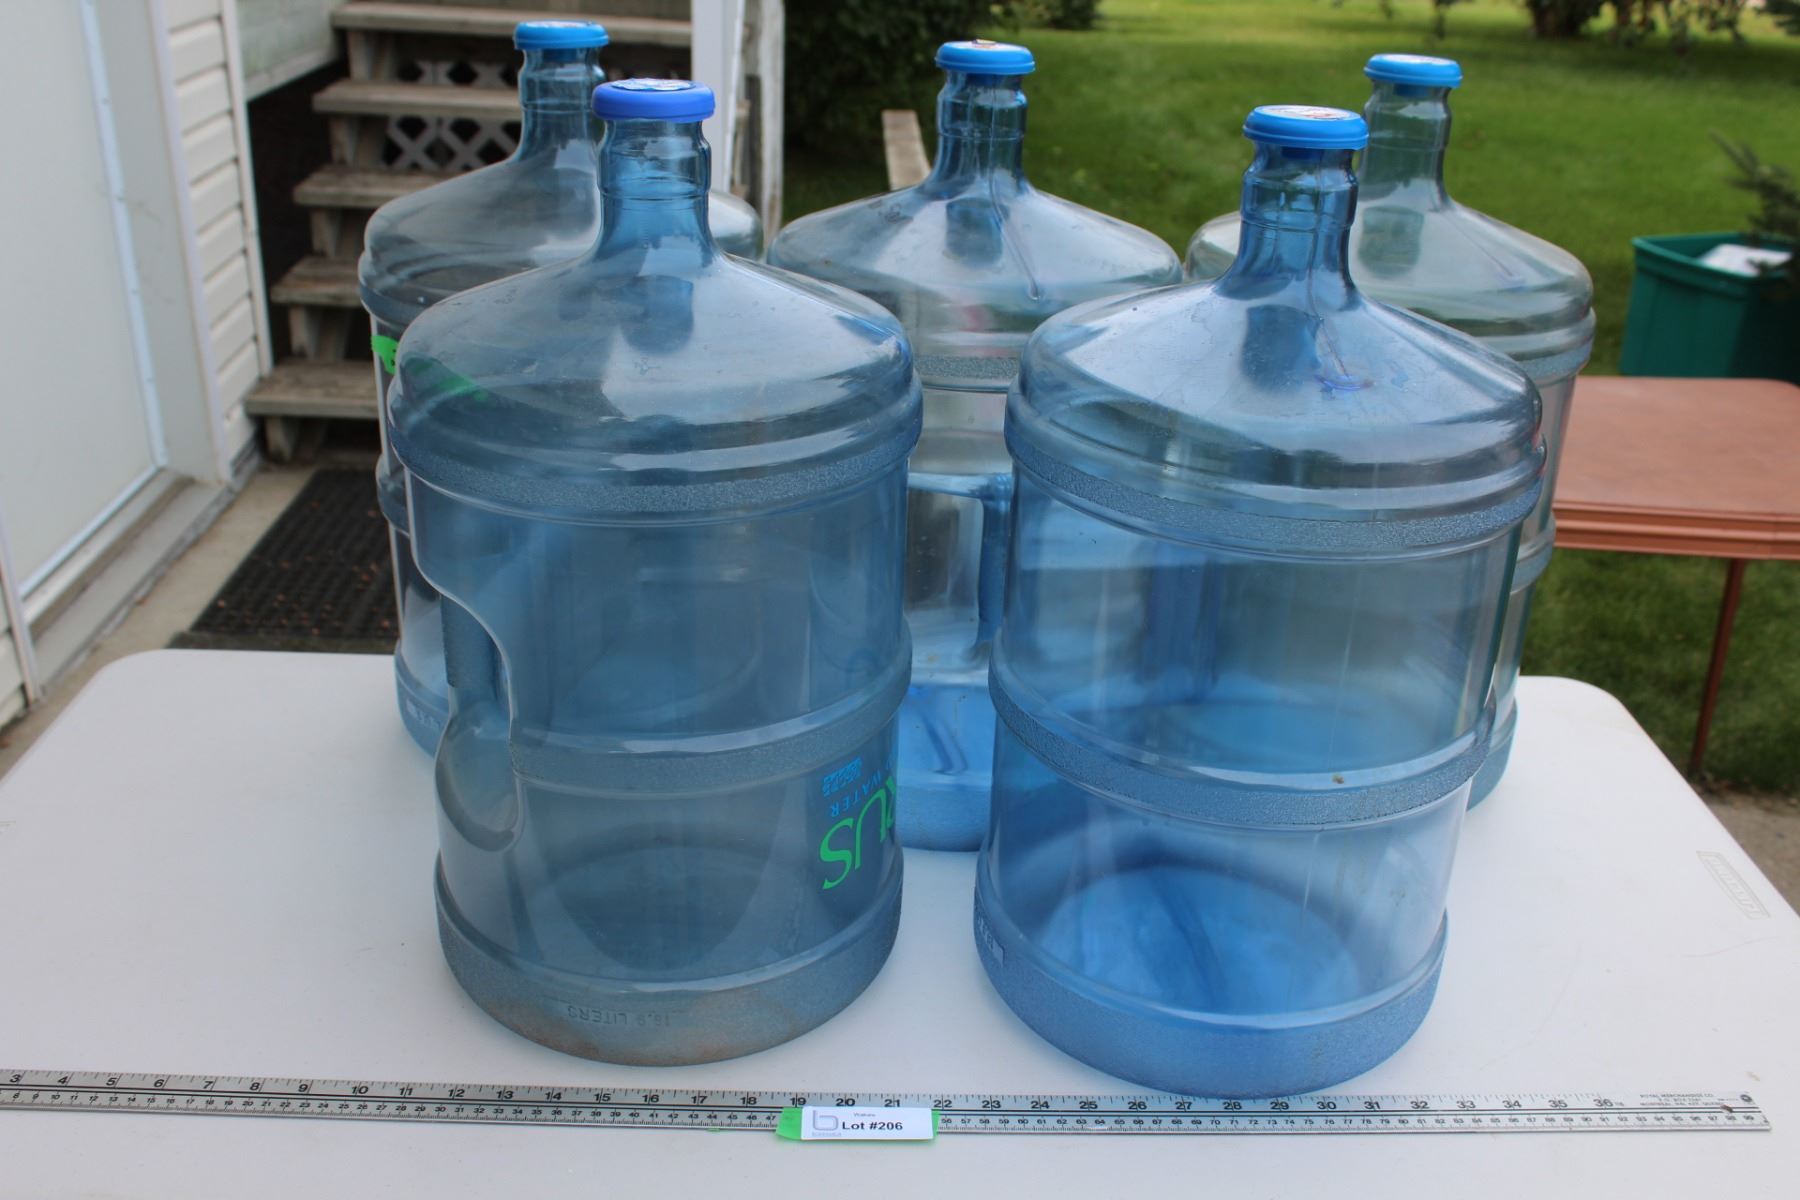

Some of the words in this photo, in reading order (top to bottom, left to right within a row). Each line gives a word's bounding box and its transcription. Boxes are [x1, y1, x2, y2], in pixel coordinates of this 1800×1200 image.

[567, 1004, 628, 1025] LITERS
[10, 1074, 20, 1084] 3
[58, 1076, 68, 1084] 4
[106, 1078, 117, 1086] 5
[154, 1079, 164, 1087] 6
[250, 1082, 260, 1090] 8
[299, 1083, 309, 1092] 9
[352, 1086, 368, 1094] 10
[399, 1087, 413, 1095] 11
[448, 1088, 464, 1097] 12
[497, 1090, 513, 1099] 13
[546, 1091, 562, 1100] 14
[594, 1092, 610, 1101] 15
[643, 1094, 660, 1103] 16
[692, 1095, 708, 1104] 17
[741, 1097, 757, 1105] 18
[790, 1097, 806, 1106] 19
[836, 1098, 855, 1107] 20
[884, 1100, 900, 1108] 21
[934, 1100, 952, 1108] 22
[982, 1100, 1001, 1109] 23
[1031, 1101, 1050, 1109] 24
[1080, 1101, 1098, 1110] 25
[1128, 1102, 1146, 1110] 26
[1176, 1101, 1192, 1110] 27
[1223, 1102, 1242, 1110] 28
[1271, 1102, 1289, 1110] 29
[1318, 1102, 1336, 1110] 30
[1364, 1102, 1380, 1110] 31
[1411, 1102, 1429, 1110] 32
[1502, 1100, 1522, 1109] 34
[1548, 1100, 1568, 1108] 35
[1594, 1100, 1613, 1108] 36
[842, 1122, 864, 1130] Lot
[869, 1122, 903, 1130] #206
